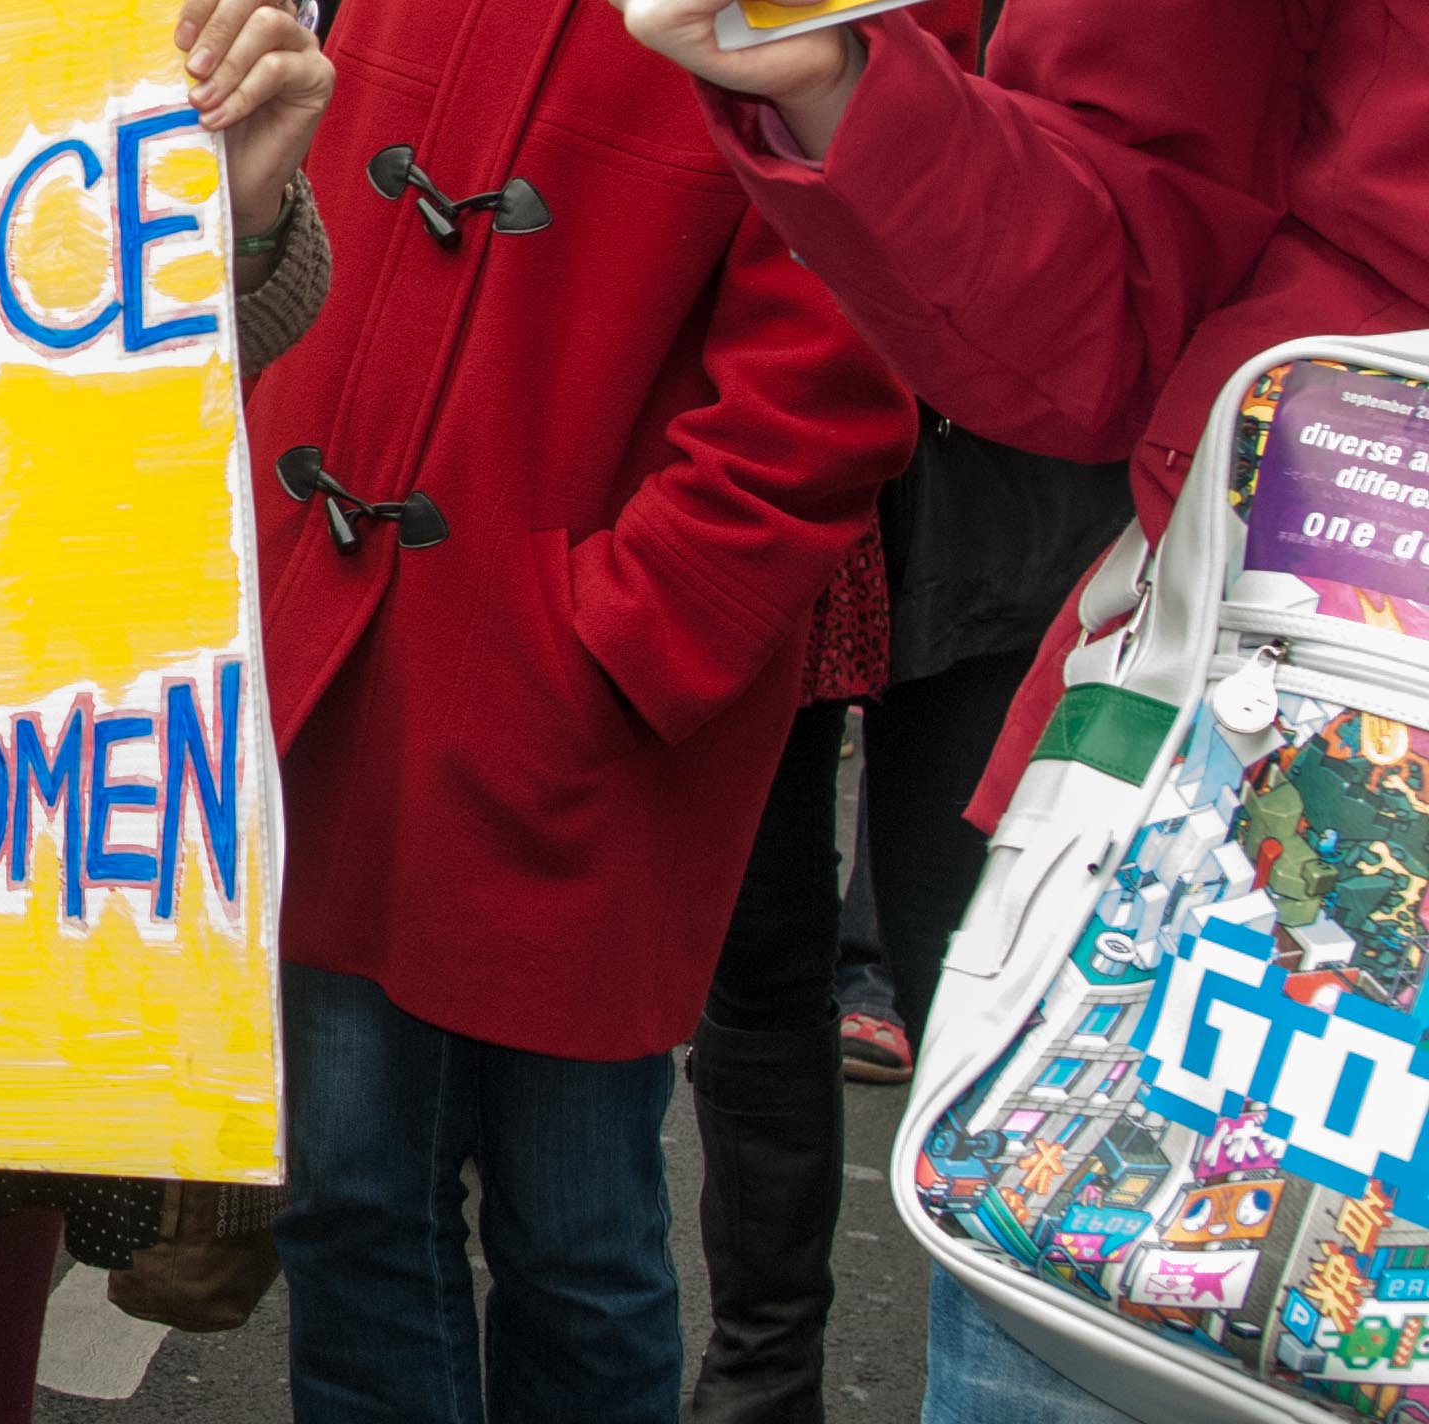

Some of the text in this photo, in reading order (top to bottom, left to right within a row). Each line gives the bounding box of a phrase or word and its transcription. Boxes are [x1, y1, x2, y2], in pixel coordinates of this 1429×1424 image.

[1341, 389, 1415, 417] september
[1298, 422, 1403, 467] diverse
[1302, 512, 1377, 549] one
